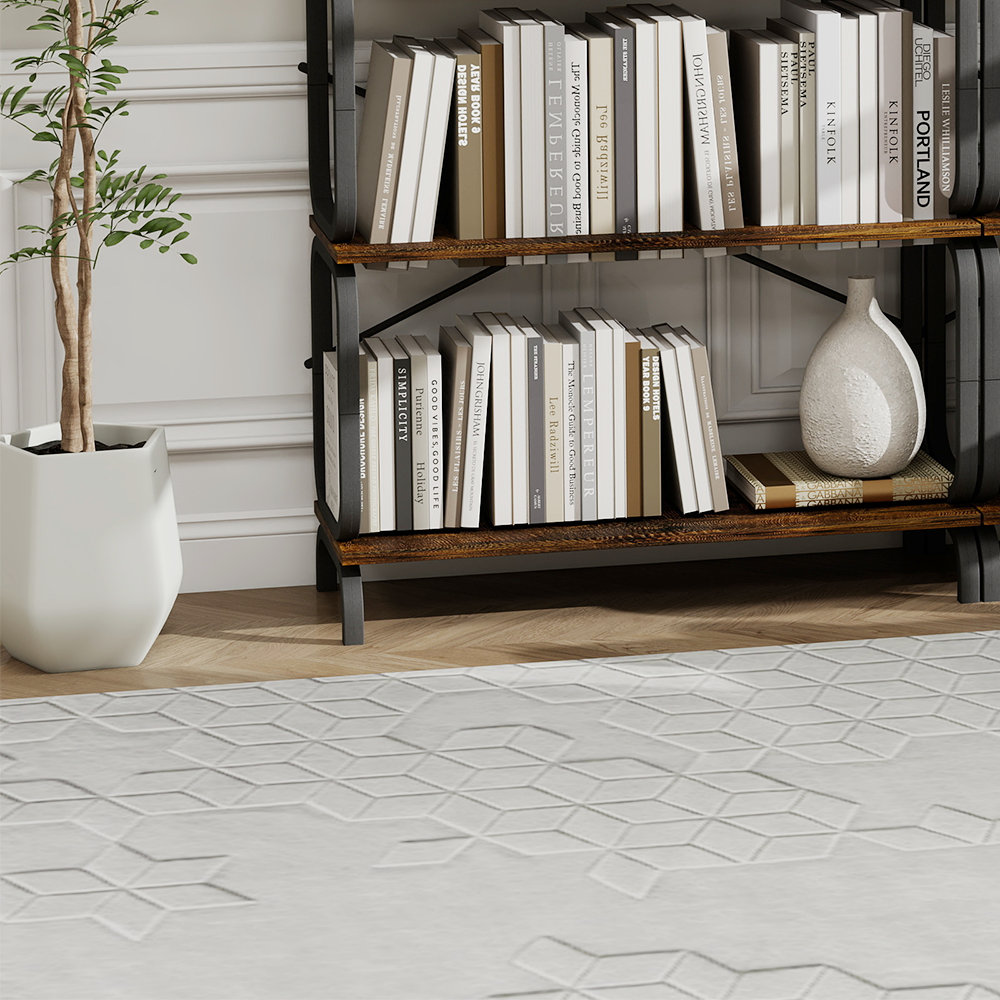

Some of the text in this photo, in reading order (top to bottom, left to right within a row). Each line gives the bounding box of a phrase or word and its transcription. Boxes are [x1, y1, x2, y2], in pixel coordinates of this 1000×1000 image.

[914, 37, 923, 87] UCHITEL
[922, 44, 931, 80] DIEGO
[942, 83, 950, 116] LESLIE
[827, 101, 836, 164] KINFOLK
[889, 101, 898, 163] KINFOLK
[916, 110, 930, 208] PORTLAND
[398, 367, 408, 442] SIMPLICITY
[549, 398, 560, 472] Lee Radziwill
[583, 374, 594, 497] LEMPEREUR
[415, 388, 426, 504] Purienne Holiday
[807, 490, 862, 499] GABBANA
